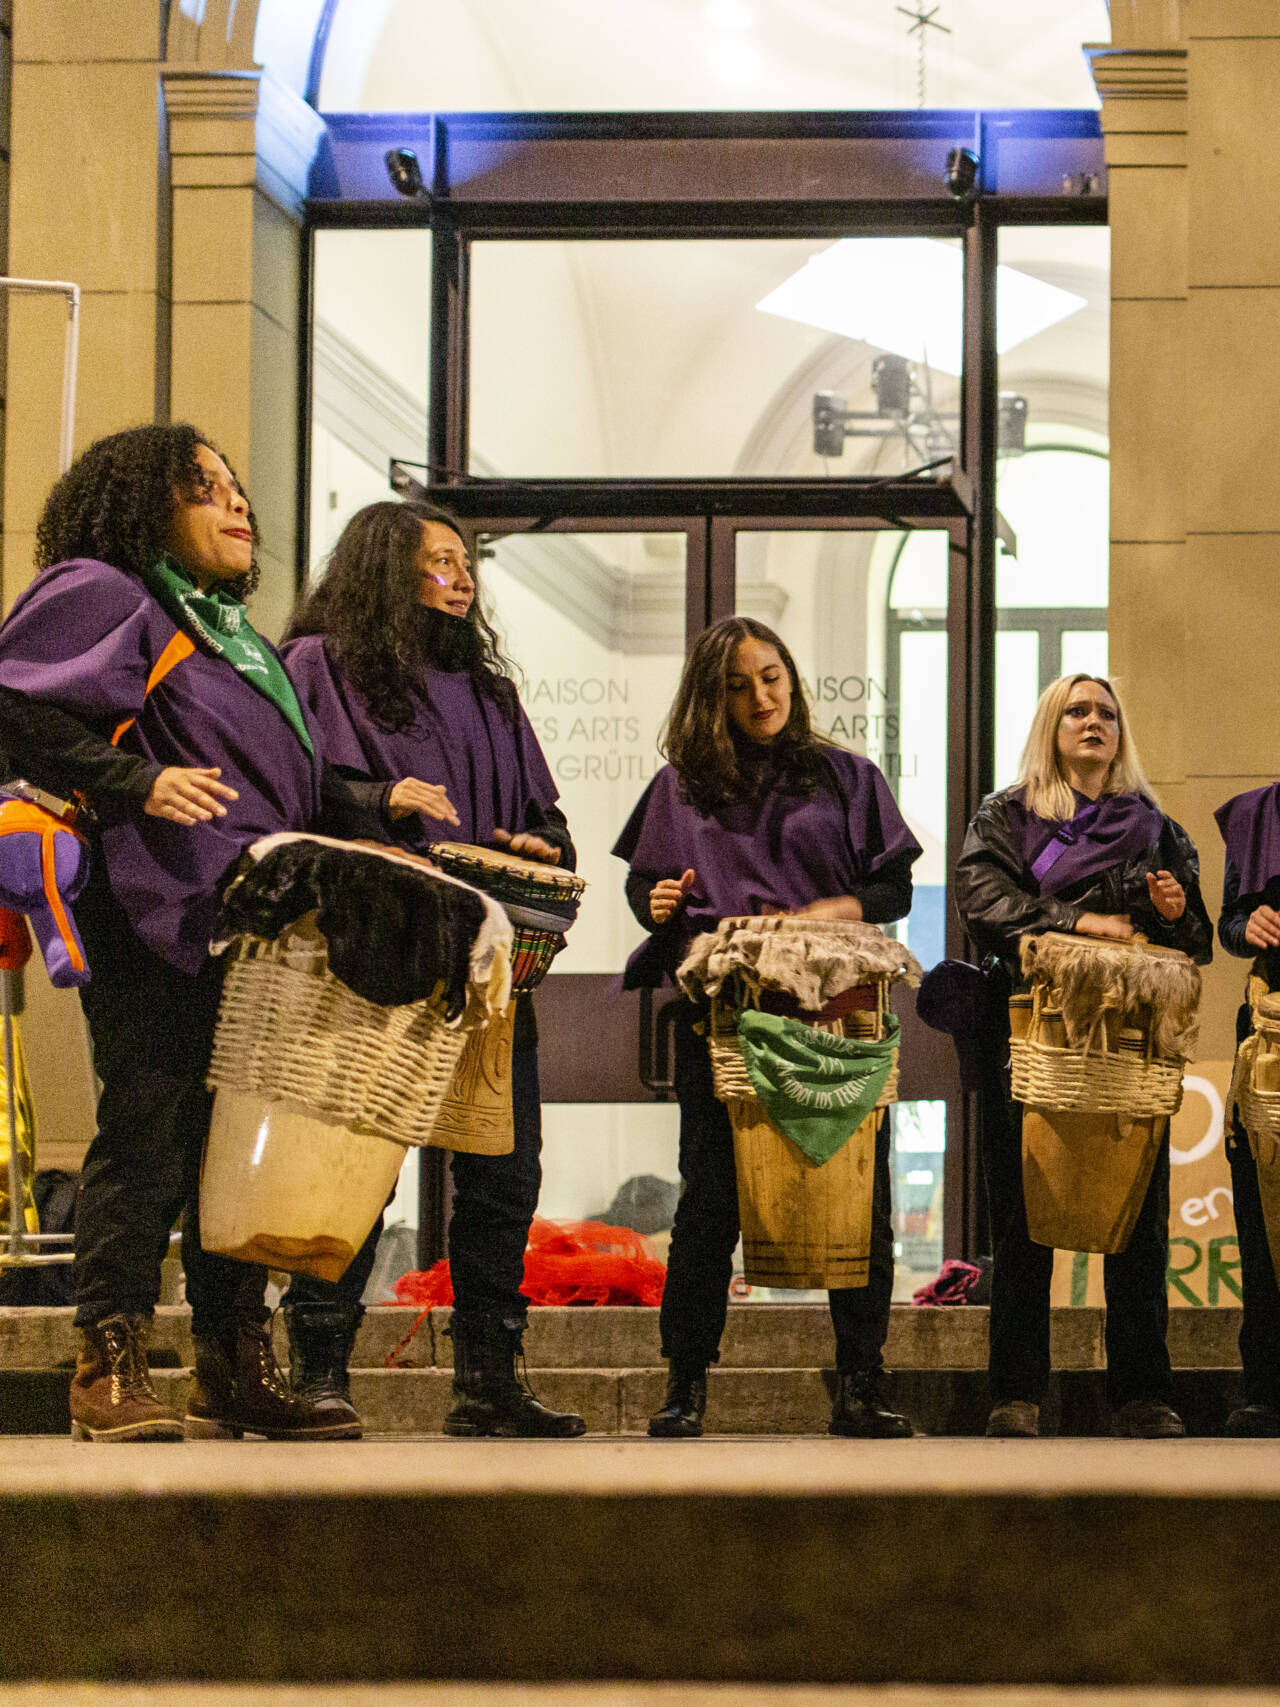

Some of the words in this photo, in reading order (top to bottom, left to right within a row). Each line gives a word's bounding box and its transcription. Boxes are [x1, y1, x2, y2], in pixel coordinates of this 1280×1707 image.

[567, 716, 640, 742] ARTS
[829, 714, 900, 740] ARTS
[815, 1091, 833, 1110] LOS
